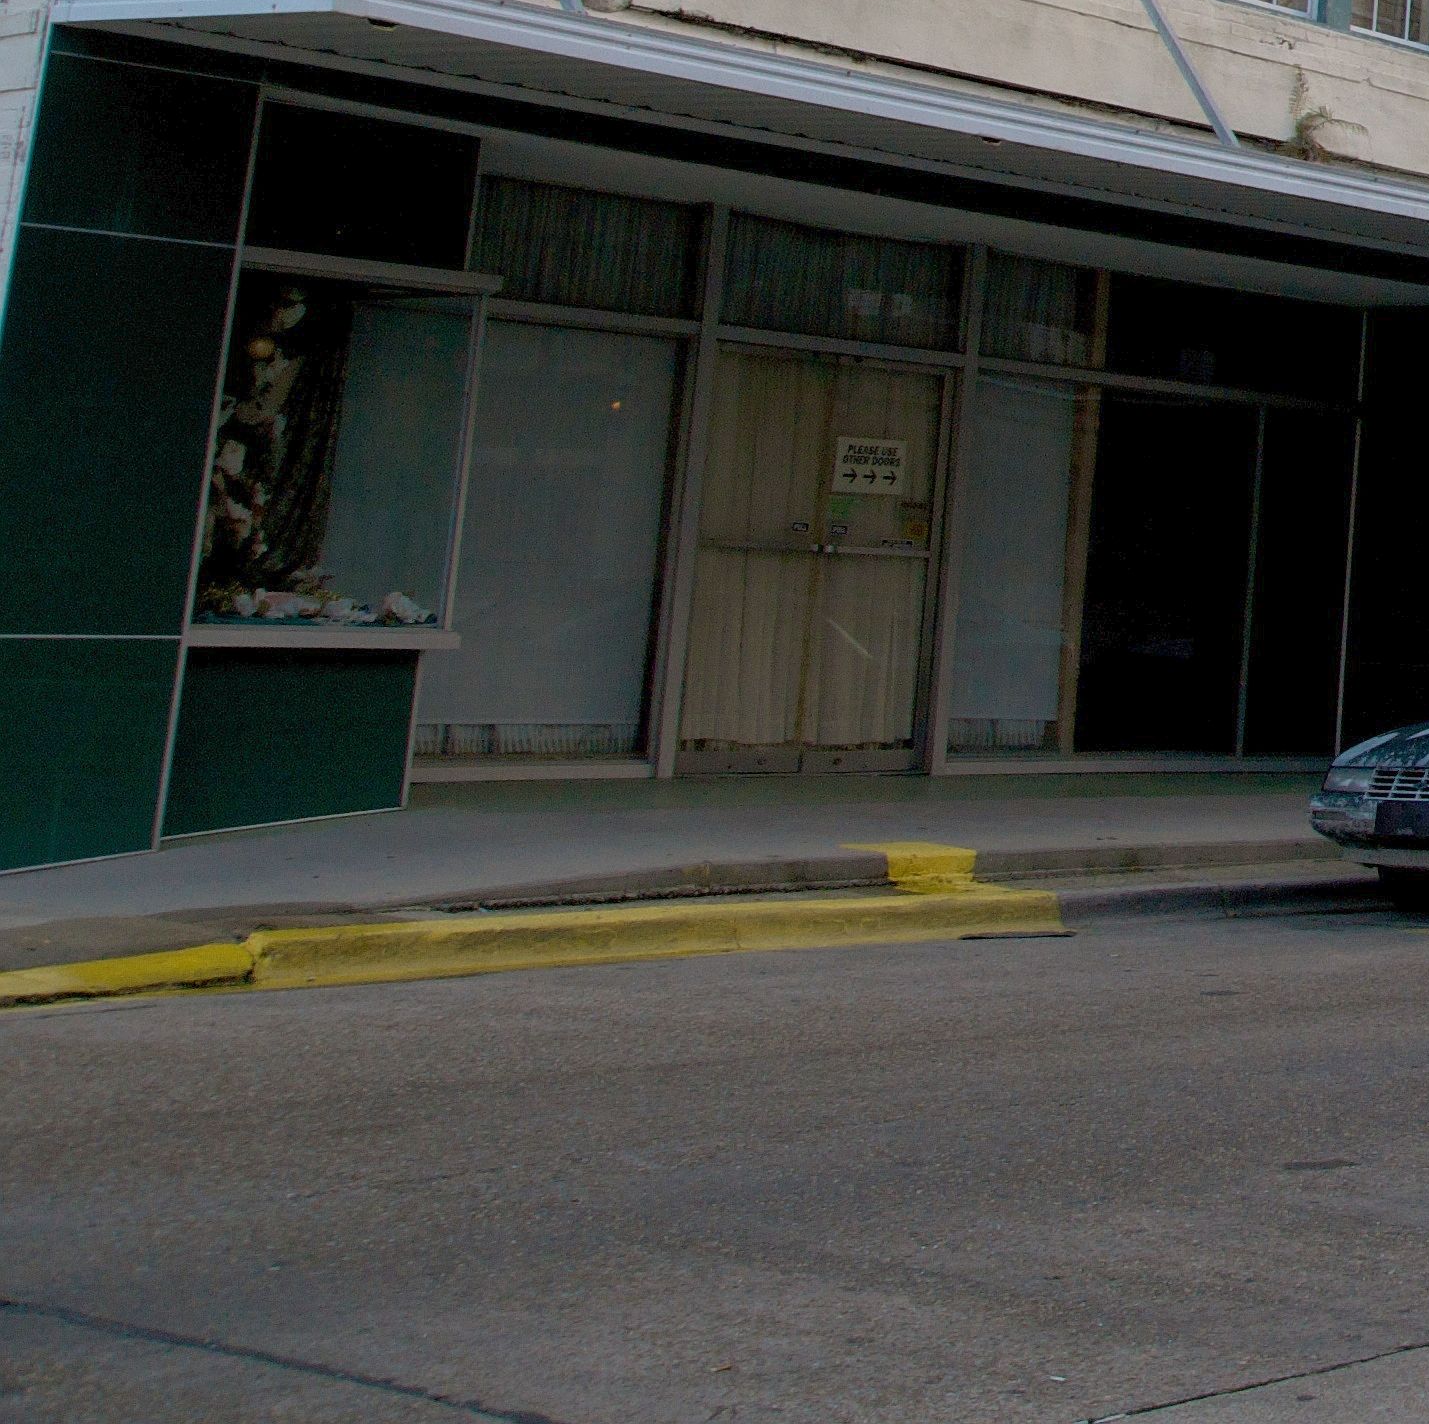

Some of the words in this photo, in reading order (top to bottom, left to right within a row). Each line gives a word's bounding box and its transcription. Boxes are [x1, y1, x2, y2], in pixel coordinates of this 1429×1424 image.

[848, 444, 879, 455] PLEASE
[881, 447, 898, 457] USE
[843, 454, 870, 465] OTHER
[871, 456, 901, 467] DOORS
